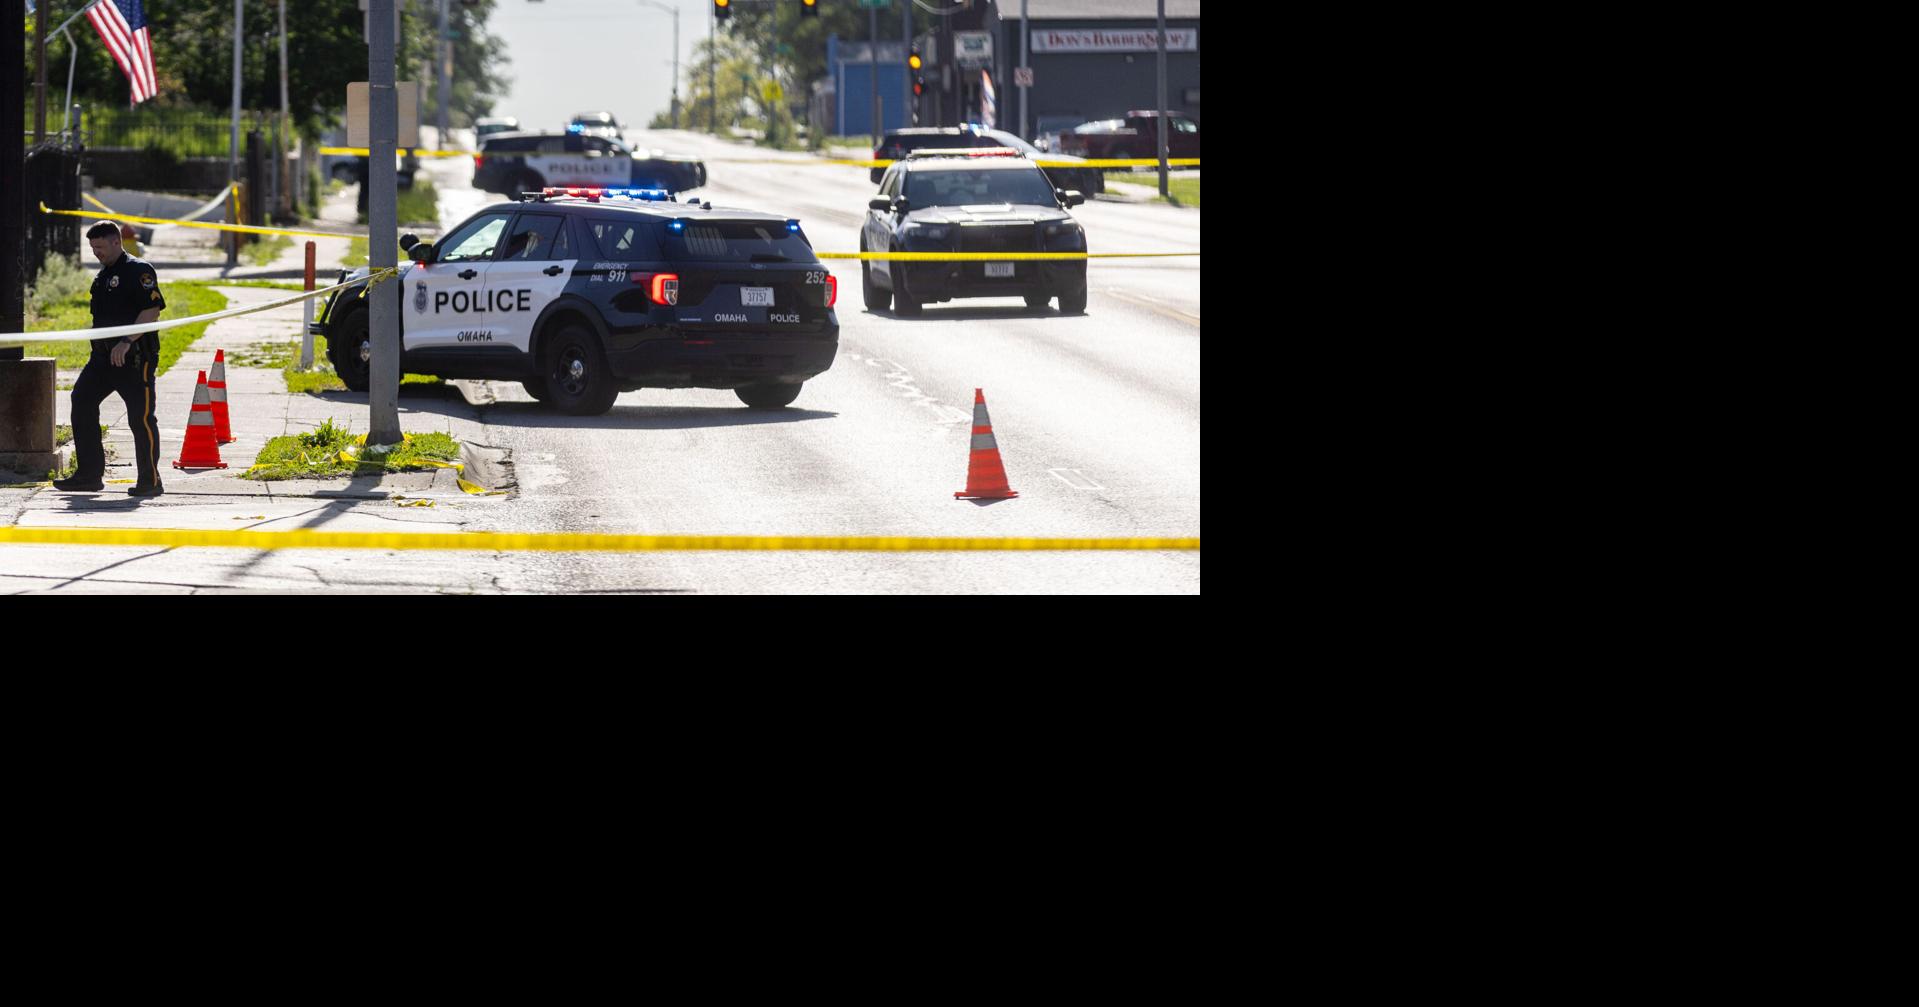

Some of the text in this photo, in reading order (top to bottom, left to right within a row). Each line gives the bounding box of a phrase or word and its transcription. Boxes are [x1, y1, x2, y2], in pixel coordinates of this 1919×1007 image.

[547, 162, 613, 175] POLICE
[607, 269, 626, 282] 911
[805, 271, 825, 284] 252
[435, 289, 532, 314] POLICE
[714, 313, 800, 323] OMAHA POLICE
[457, 330, 493, 342] OMAHA
